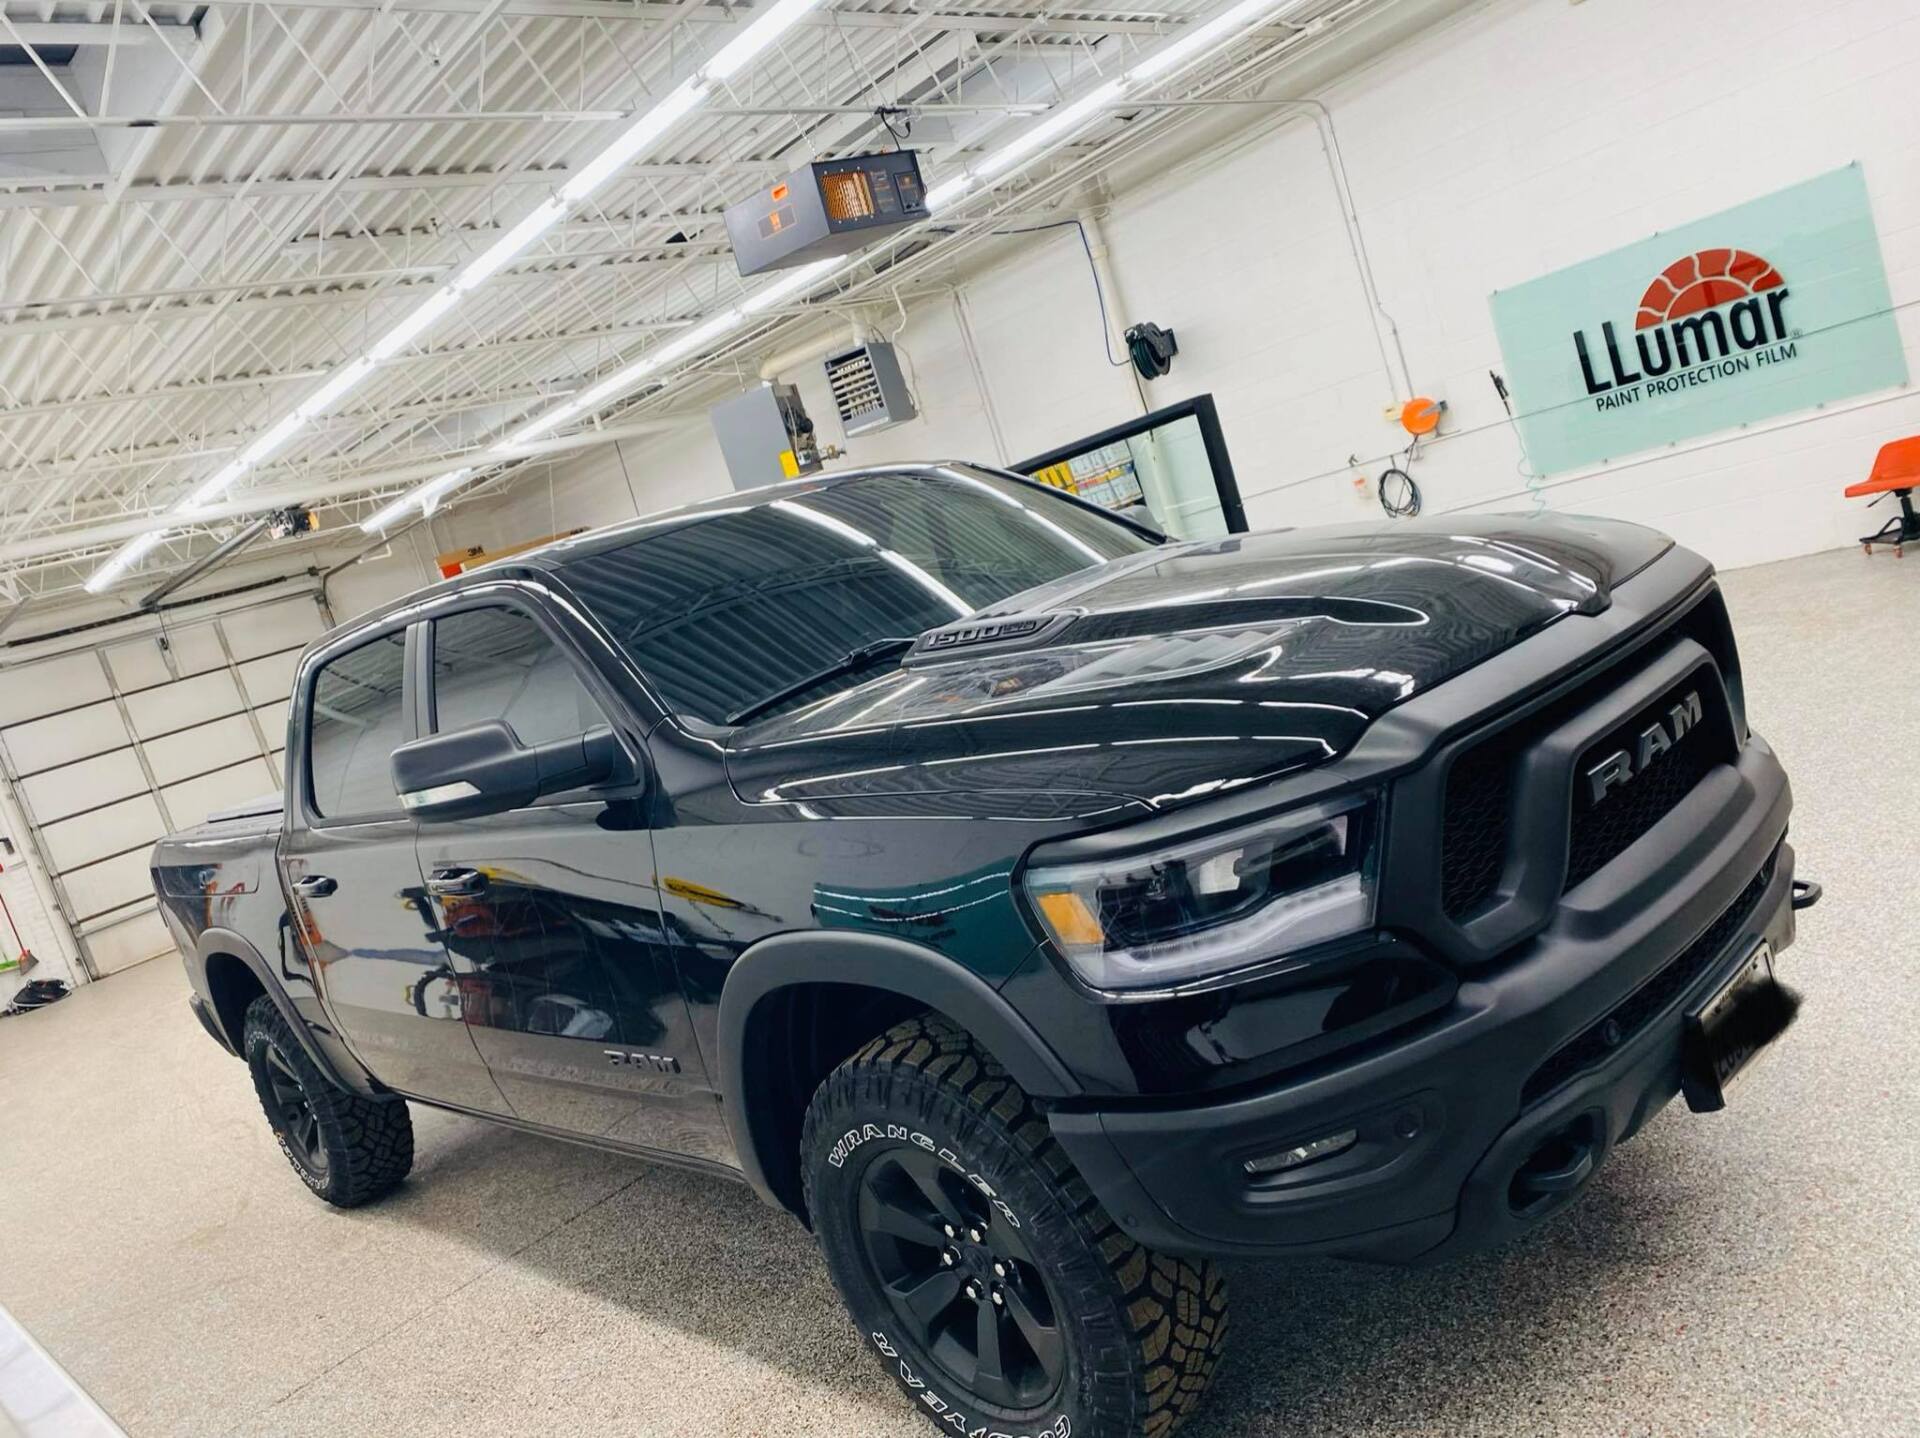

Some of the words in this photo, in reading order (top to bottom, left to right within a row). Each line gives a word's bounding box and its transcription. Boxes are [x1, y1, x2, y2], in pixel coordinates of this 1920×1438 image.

[1573, 288, 1789, 394] LLumar
[1595, 387, 1642, 412] PAINT
[1647, 355, 1750, 398] PROTECTION
[1756, 342, 1798, 367] FILM
[927, 624, 1003, 647] 1500
[1586, 689, 1704, 807] RAM
[603, 1050, 682, 1074] RAM
[828, 1123, 1021, 1230] WRANGLER
[871, 1331, 1072, 1438] GYEAR
